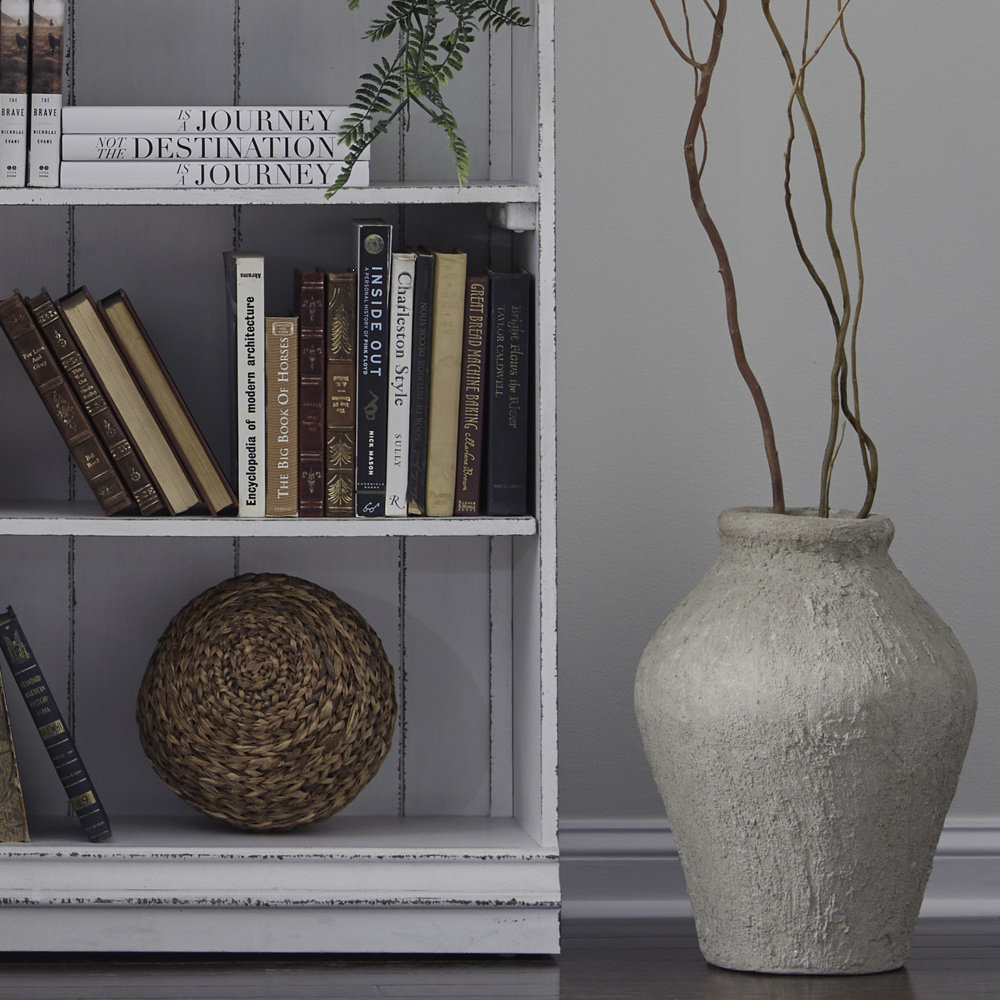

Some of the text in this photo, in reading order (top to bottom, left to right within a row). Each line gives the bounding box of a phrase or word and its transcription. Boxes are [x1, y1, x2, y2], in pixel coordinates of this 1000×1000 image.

[1, 108, 25, 117] BRAVE
[33, 108, 57, 117] BRAVE
[177, 109, 336, 131] IS A JOURNEY
[96, 136, 336, 159] NOT THE DESTINATION
[175, 163, 335, 186] IS A JOURNEY
[363, 330, 369, 338] OF
[371, 266, 383, 376] INSIDE OUT
[417, 302, 428, 358] DECORATION
[391, 271, 413, 407] Charleston Style
[463, 283, 485, 430] GREAT BREAD MACHINE BAKING
[495, 306, 505, 398] TAYLOR CALDWELL
[506, 306, 523, 429] Bright Flows the River
[245, 296, 259, 506] Encyclopedia of modern architecture
[277, 337, 290, 499] THE BIG BOOK OF HORSES
[393, 433, 402, 468] SULLY
[462, 432, 476, 466] Marlene
[462, 465, 474, 491] Brown
